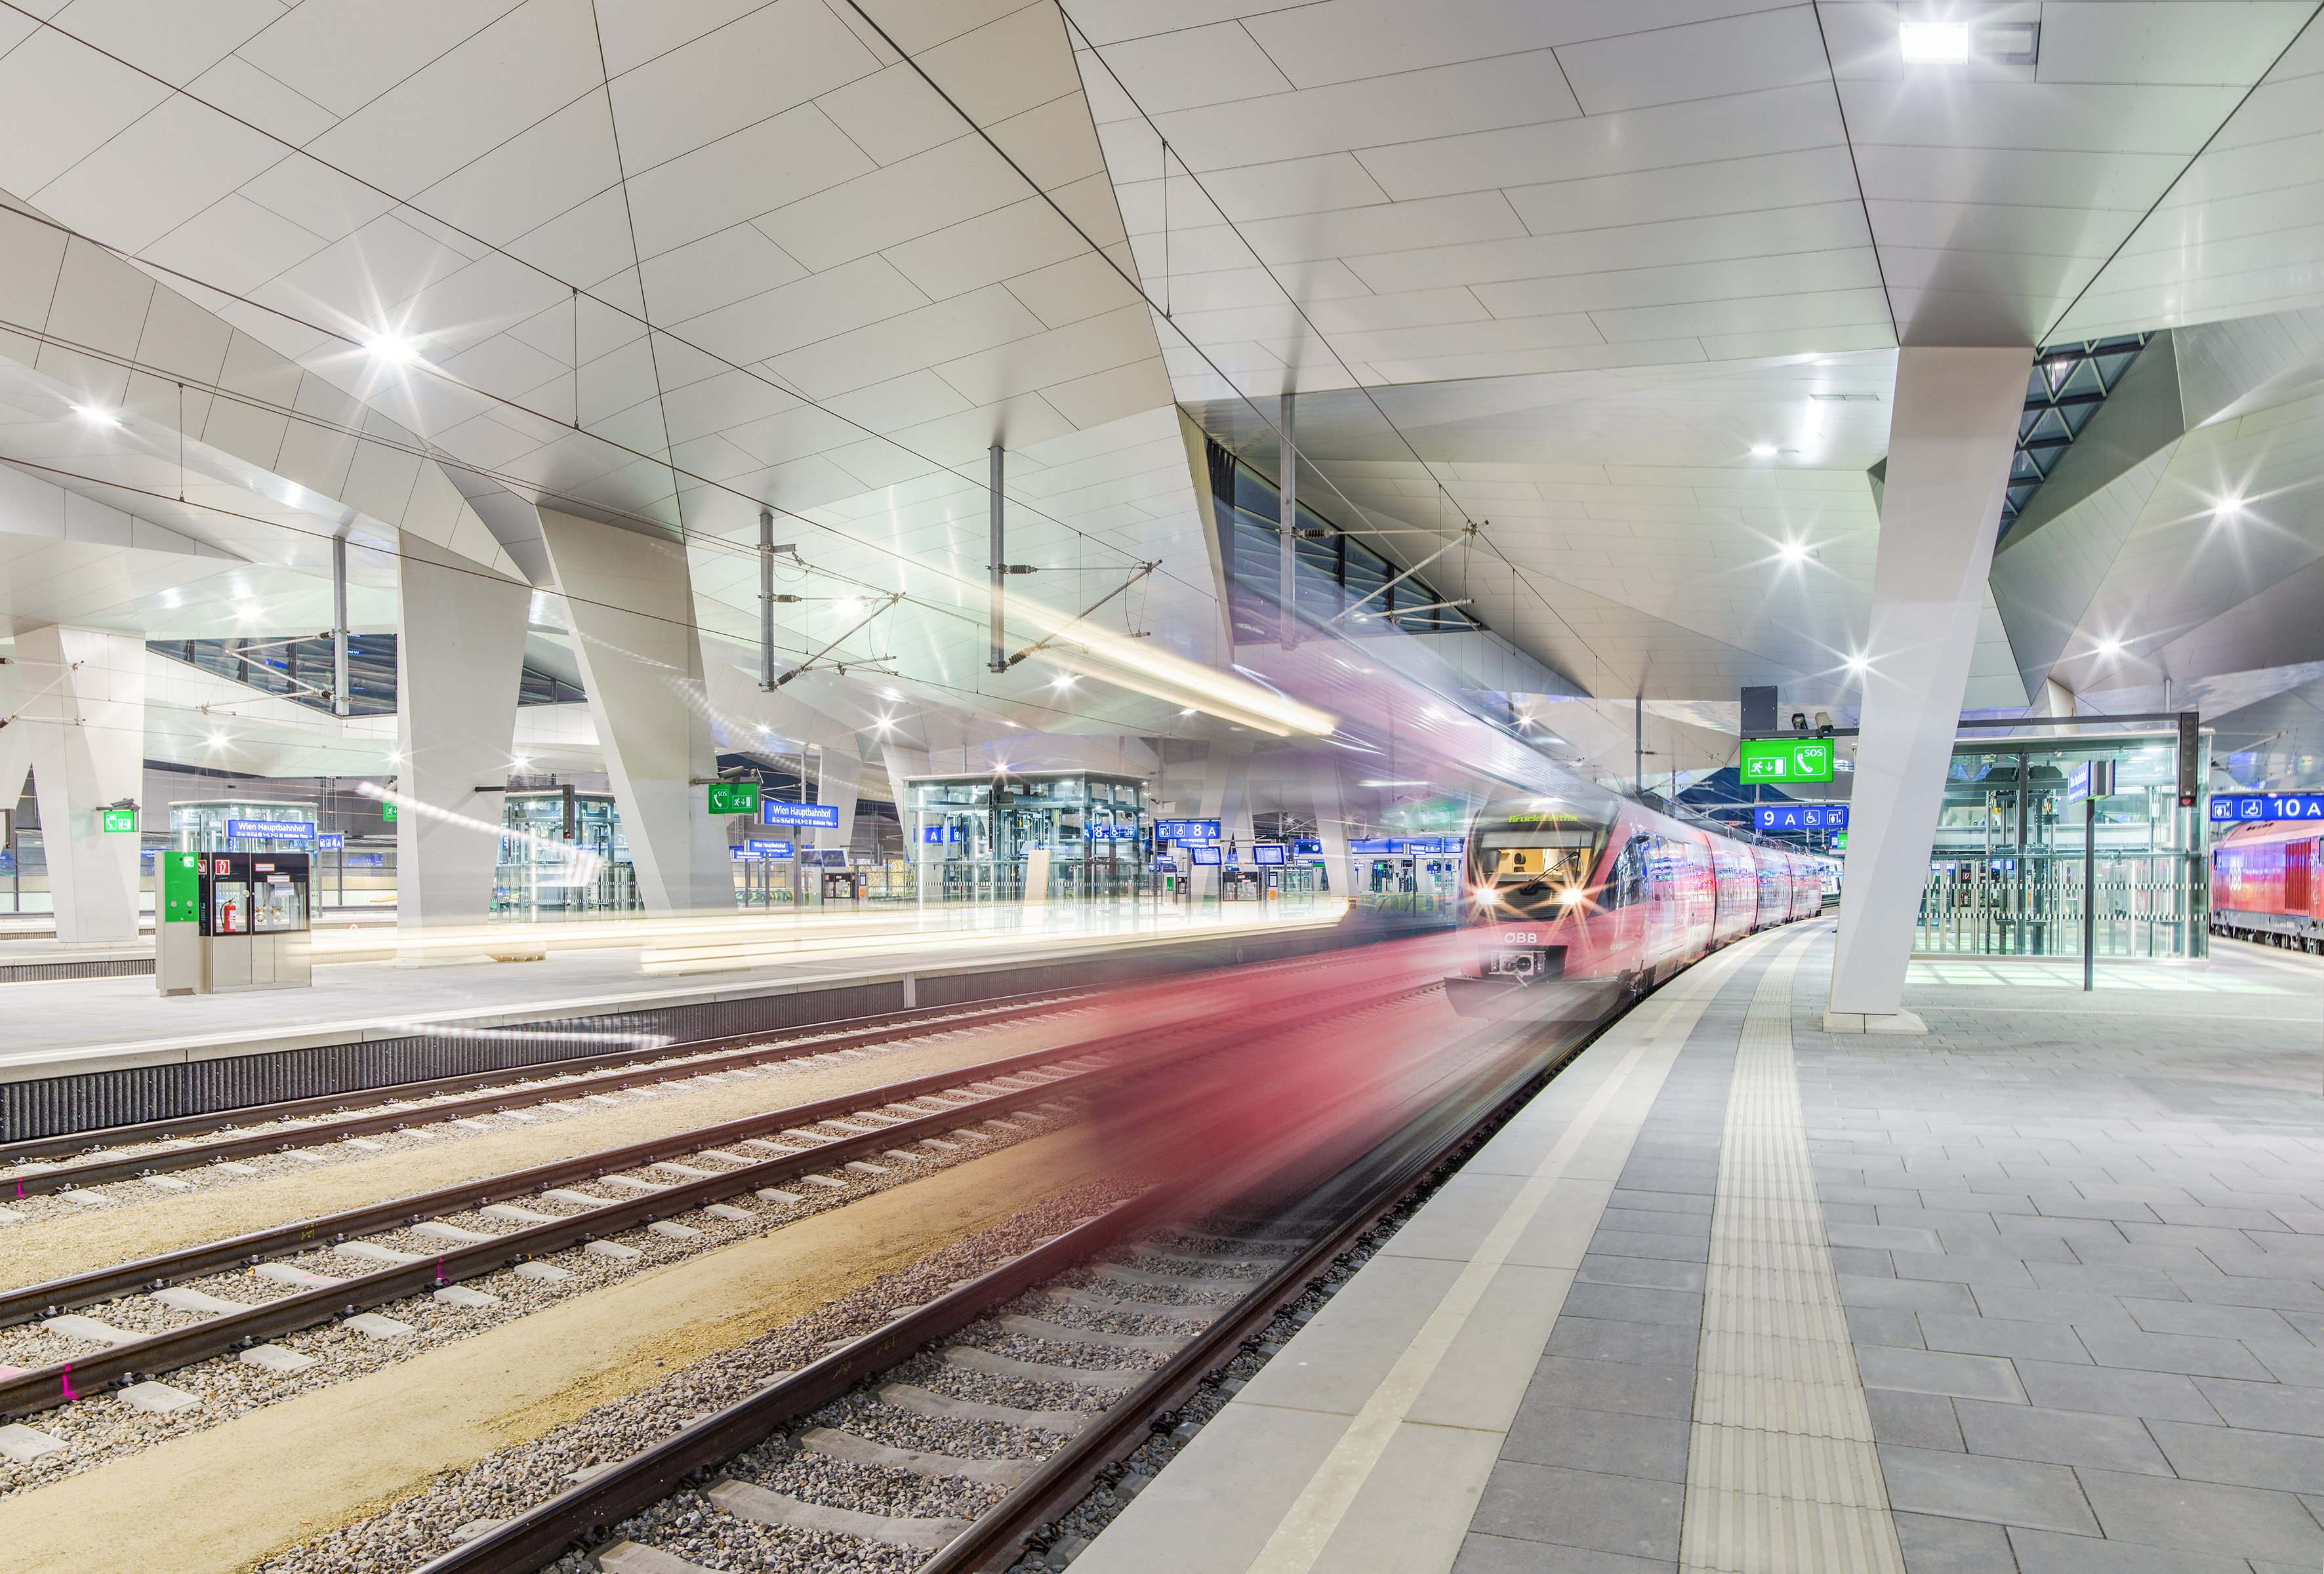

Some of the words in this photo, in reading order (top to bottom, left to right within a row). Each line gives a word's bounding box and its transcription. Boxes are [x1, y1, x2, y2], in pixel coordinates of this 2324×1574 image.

[773, 805, 789, 815] Wien
[790, 807, 831, 818] Hauptbahnhof
[2274, 799, 2300, 817] 10
[2307, 802, 2321, 816] A
[1764, 811, 1774, 826] 9
[1785, 814, 1796, 825] A
[258, 824, 306, 833] Hauptbahnhof
[1095, 826, 1103, 837] 8
[1193, 824, 1202, 836] 8
[1208, 827, 1216, 836] A
[931, 832, 937, 841] A
[332, 838, 336, 847] 4
[1505, 933, 1538, 944] ÖBB
